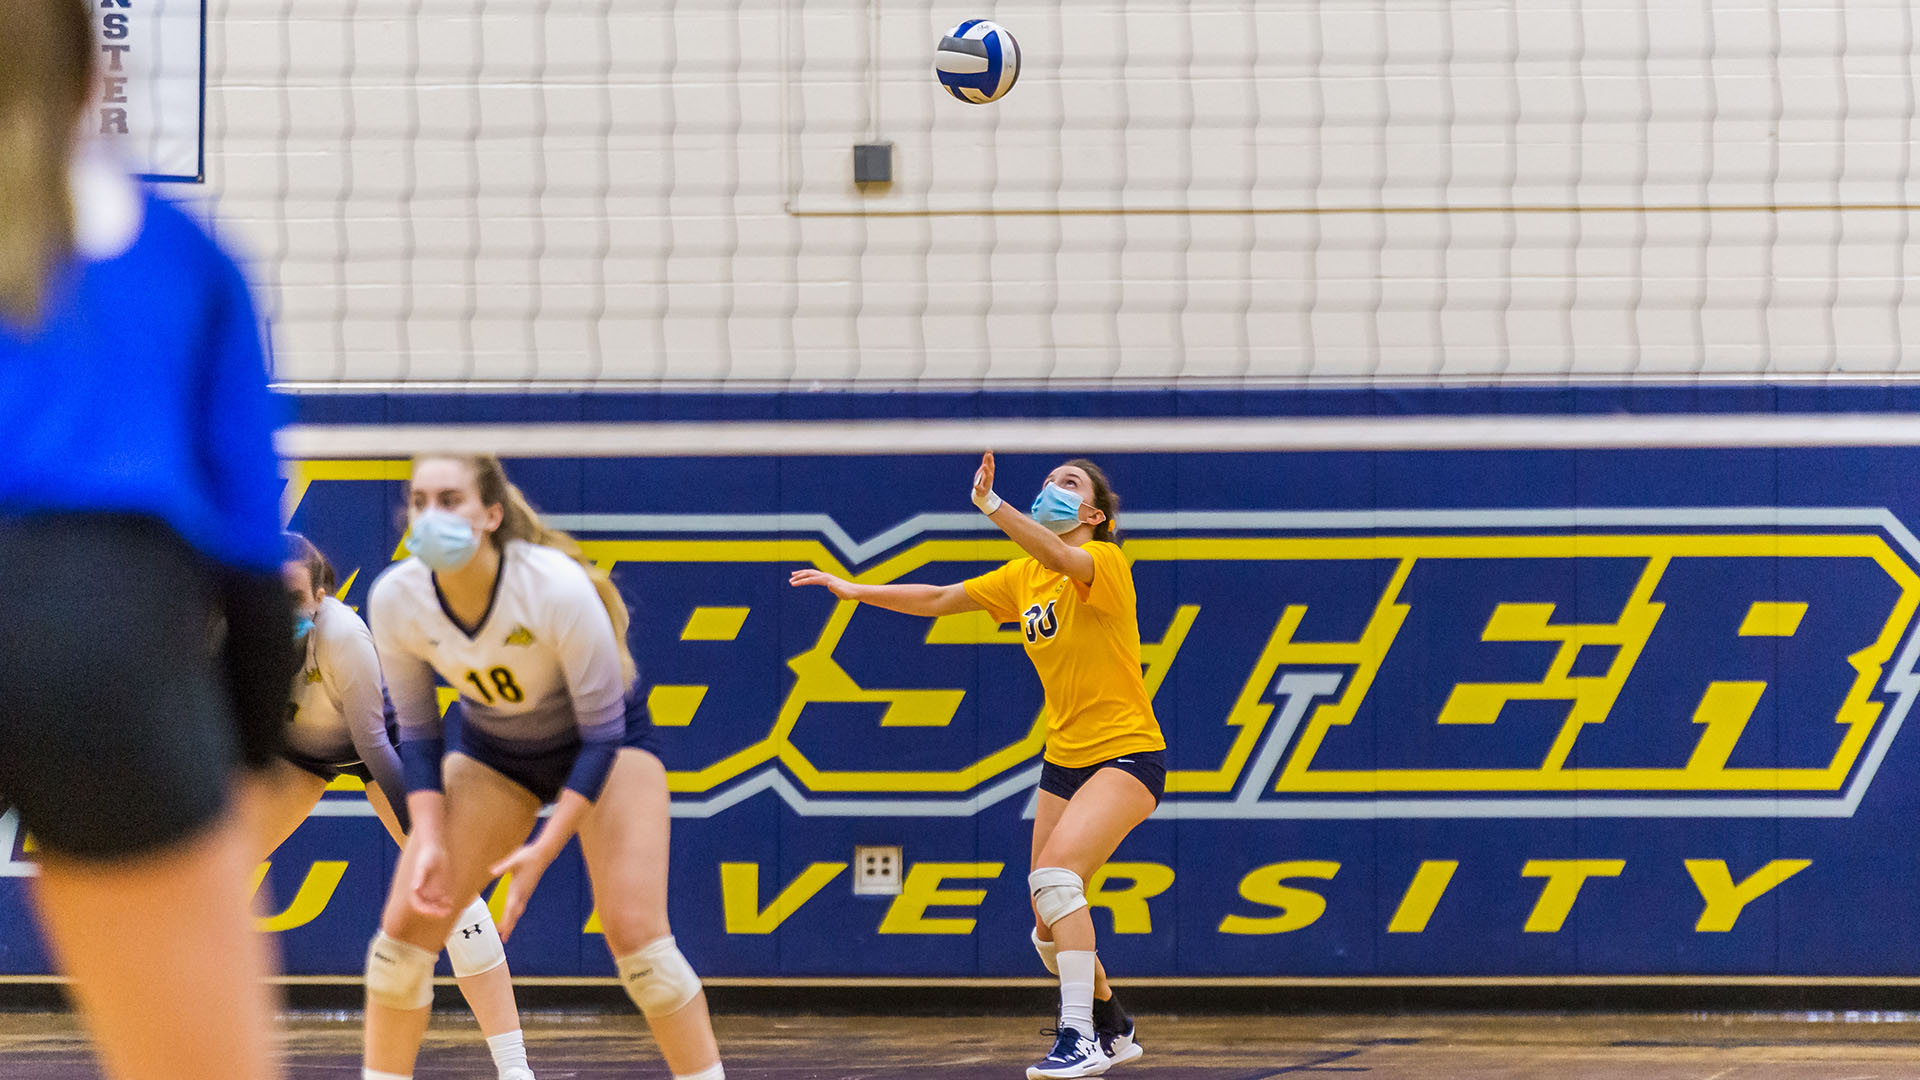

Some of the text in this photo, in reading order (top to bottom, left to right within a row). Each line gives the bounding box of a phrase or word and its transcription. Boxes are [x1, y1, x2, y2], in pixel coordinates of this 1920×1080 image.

[100, 0, 131, 134] STER
[465, 665, 524, 704] 18
[248, 858, 1813, 936] UVERSITY
